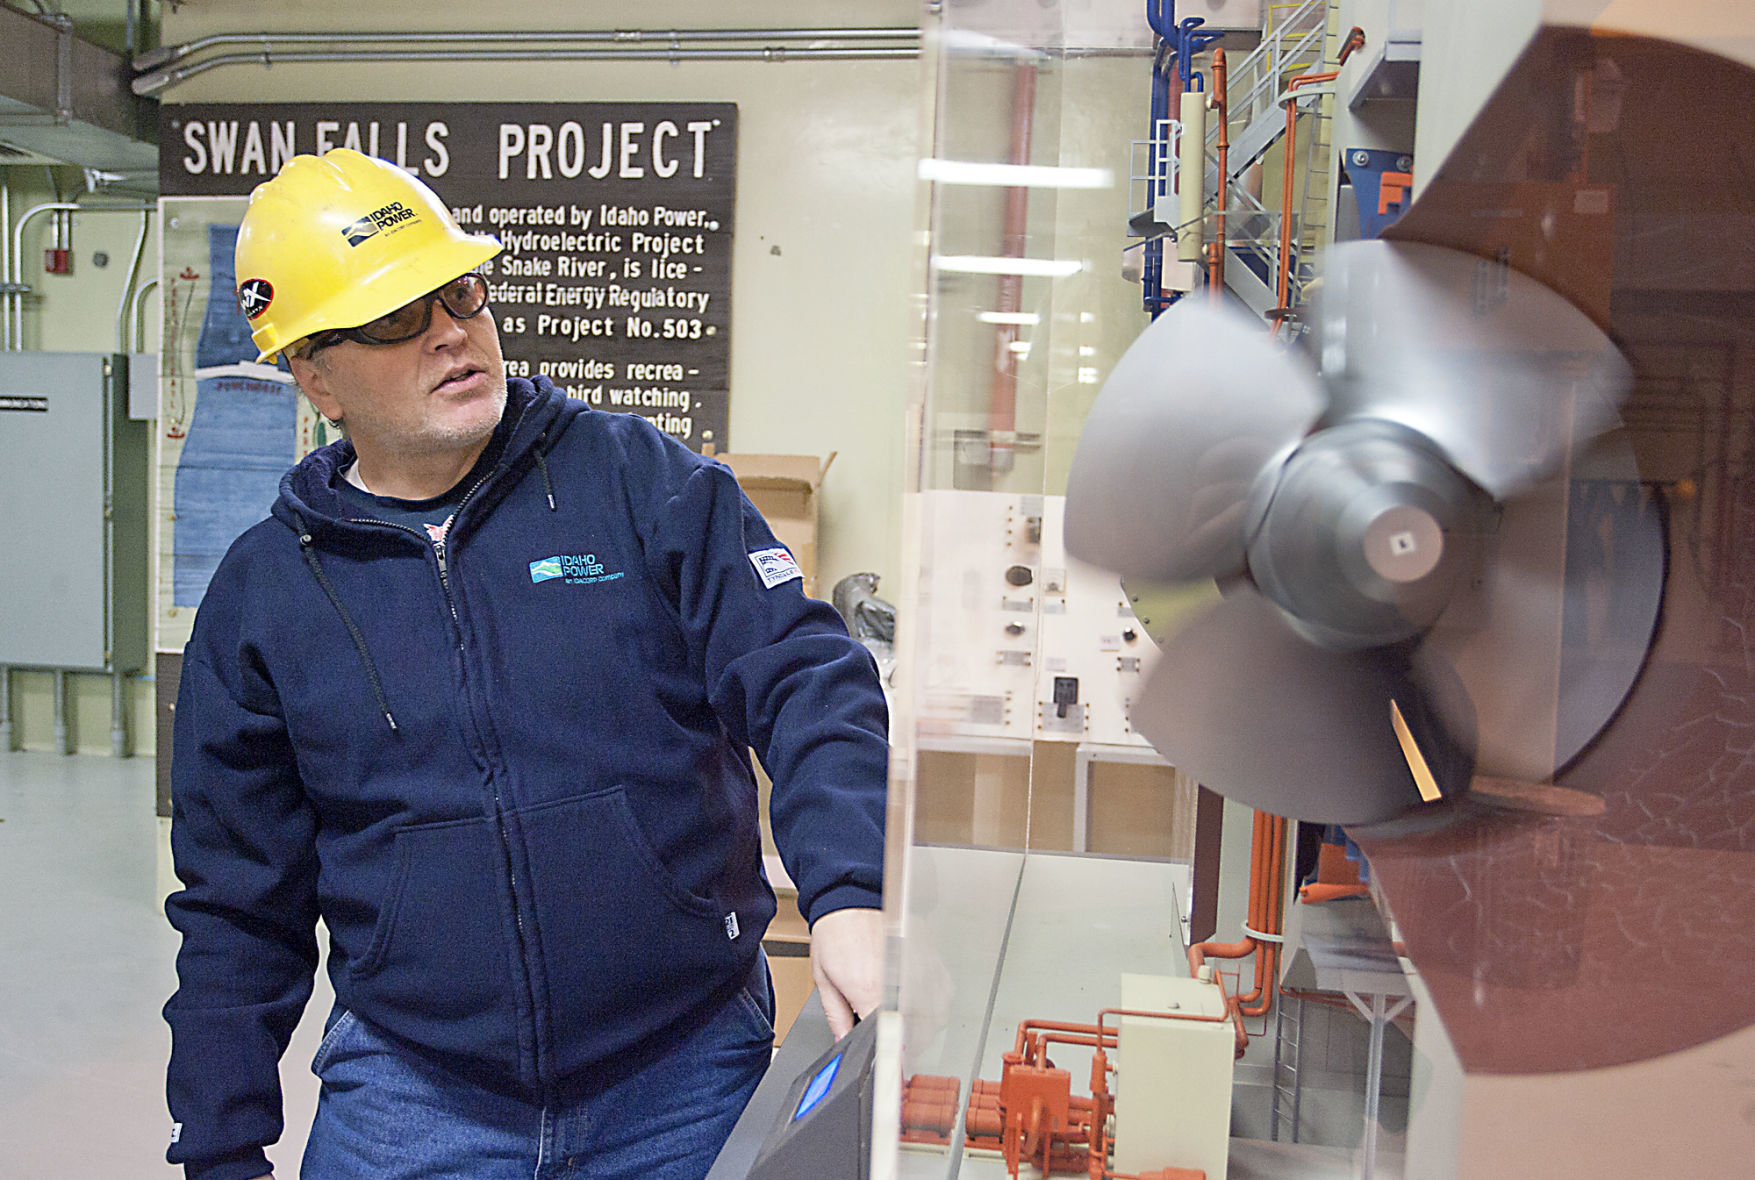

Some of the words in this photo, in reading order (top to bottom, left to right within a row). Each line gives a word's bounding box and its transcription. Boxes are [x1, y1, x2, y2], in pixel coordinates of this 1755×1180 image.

[184, 120, 296, 175] SWAN
[498, 120, 713, 180] PROJECT
[369, 201, 403, 222] IDAHO
[376, 207, 416, 231] POWER
[451, 205, 483, 225] and
[489, 205, 566, 229] operated
[570, 206, 592, 231] by
[600, 205, 650, 226] Idaho
[501, 231, 622, 255] Hydroelectric
[631, 232, 704, 259] Project
[501, 255, 552, 278] Snake
[623, 257, 641, 279] is
[488, 281, 542, 304] ederal
[545, 283, 606, 310] Energy
[608, 284, 710, 313] Regulatory
[502, 316, 526, 334] as
[537, 314, 614, 343] Project
[503, 359, 530, 377] rea
[539, 358, 615, 380] provides
[566, 384, 603, 405] bird
[561, 553, 596, 566] IDAHO
[562, 563, 605, 577] POWER
